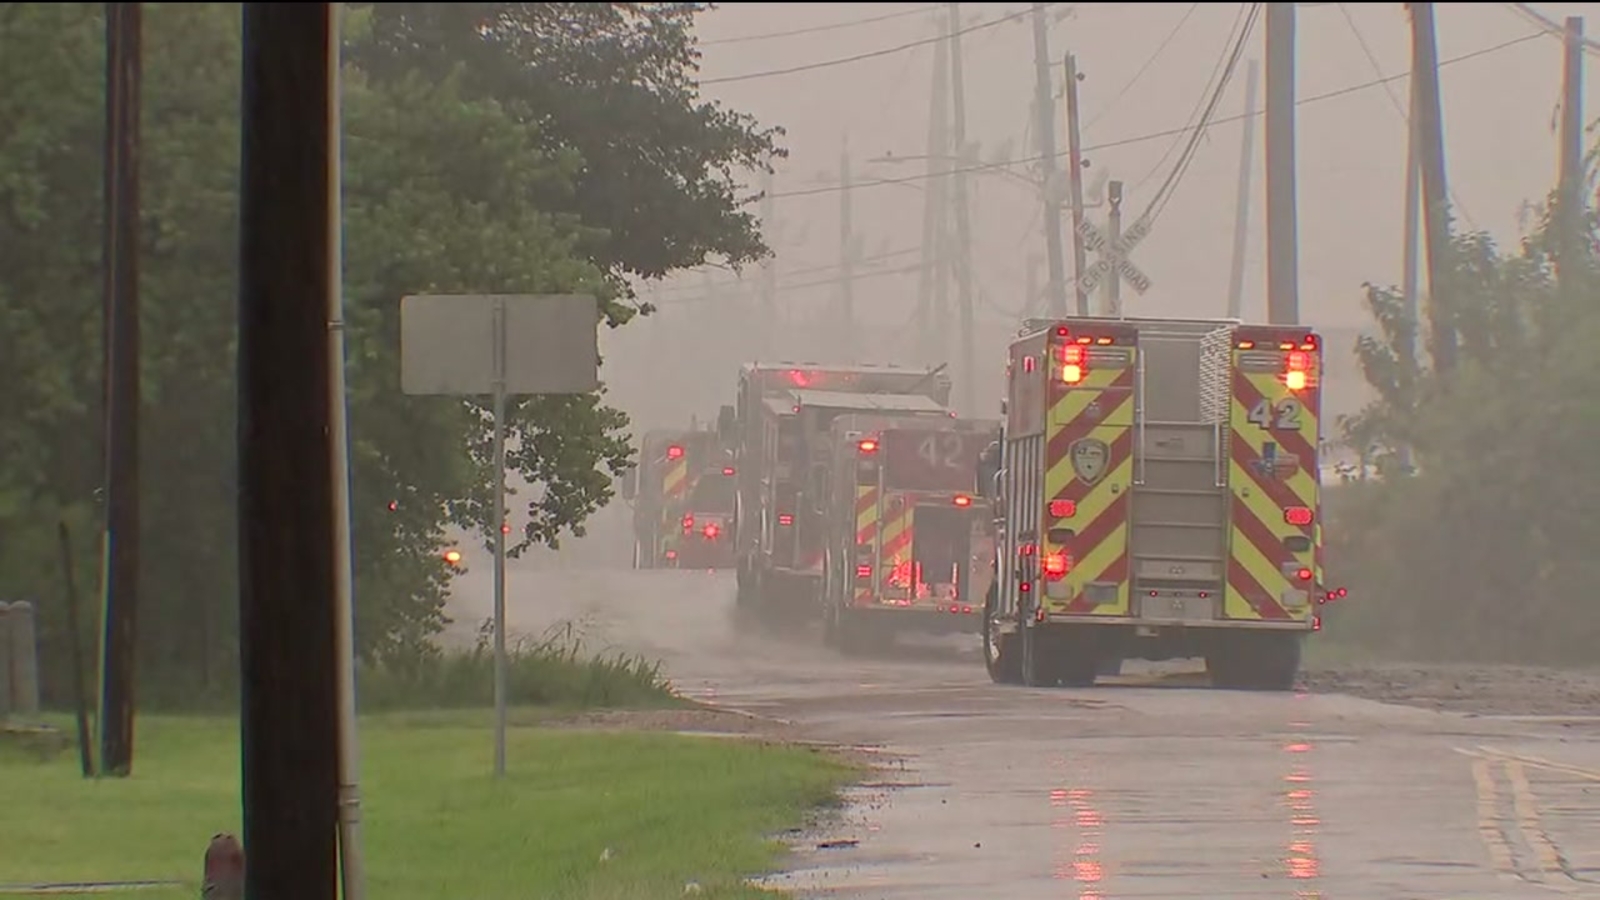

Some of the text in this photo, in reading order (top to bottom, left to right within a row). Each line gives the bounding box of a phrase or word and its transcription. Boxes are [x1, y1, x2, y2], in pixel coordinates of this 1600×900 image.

[1119, 260, 1149, 292] ROAD
[1247, 398, 1301, 430] 42
[917, 431, 963, 469] 42
